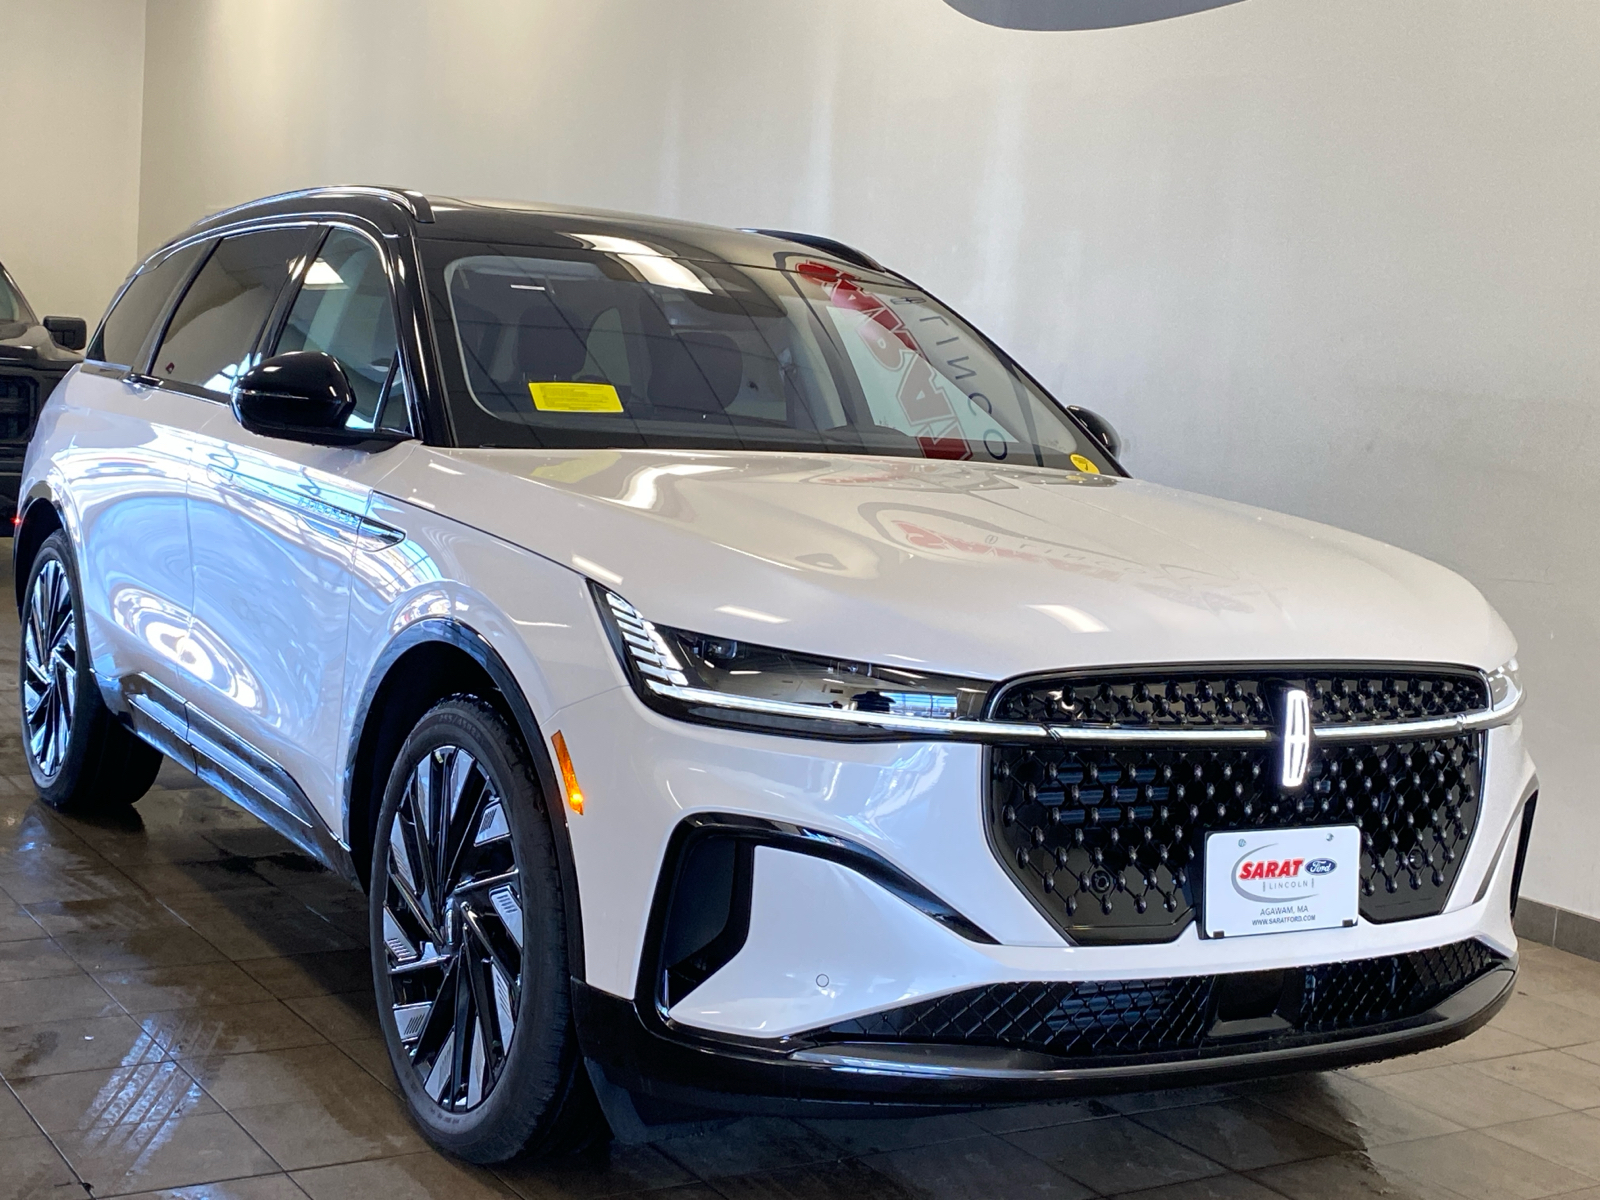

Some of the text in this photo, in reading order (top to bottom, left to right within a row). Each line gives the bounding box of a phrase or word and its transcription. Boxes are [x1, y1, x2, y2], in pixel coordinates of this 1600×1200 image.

[1239, 858, 1332, 880] SARAT Ford
[1269, 880, 1309, 890] LINCOLN
[1260, 905, 1309, 916] AGAWAM, MA
[1252, 914, 1316, 926] WWW.SARATFORD.COM
